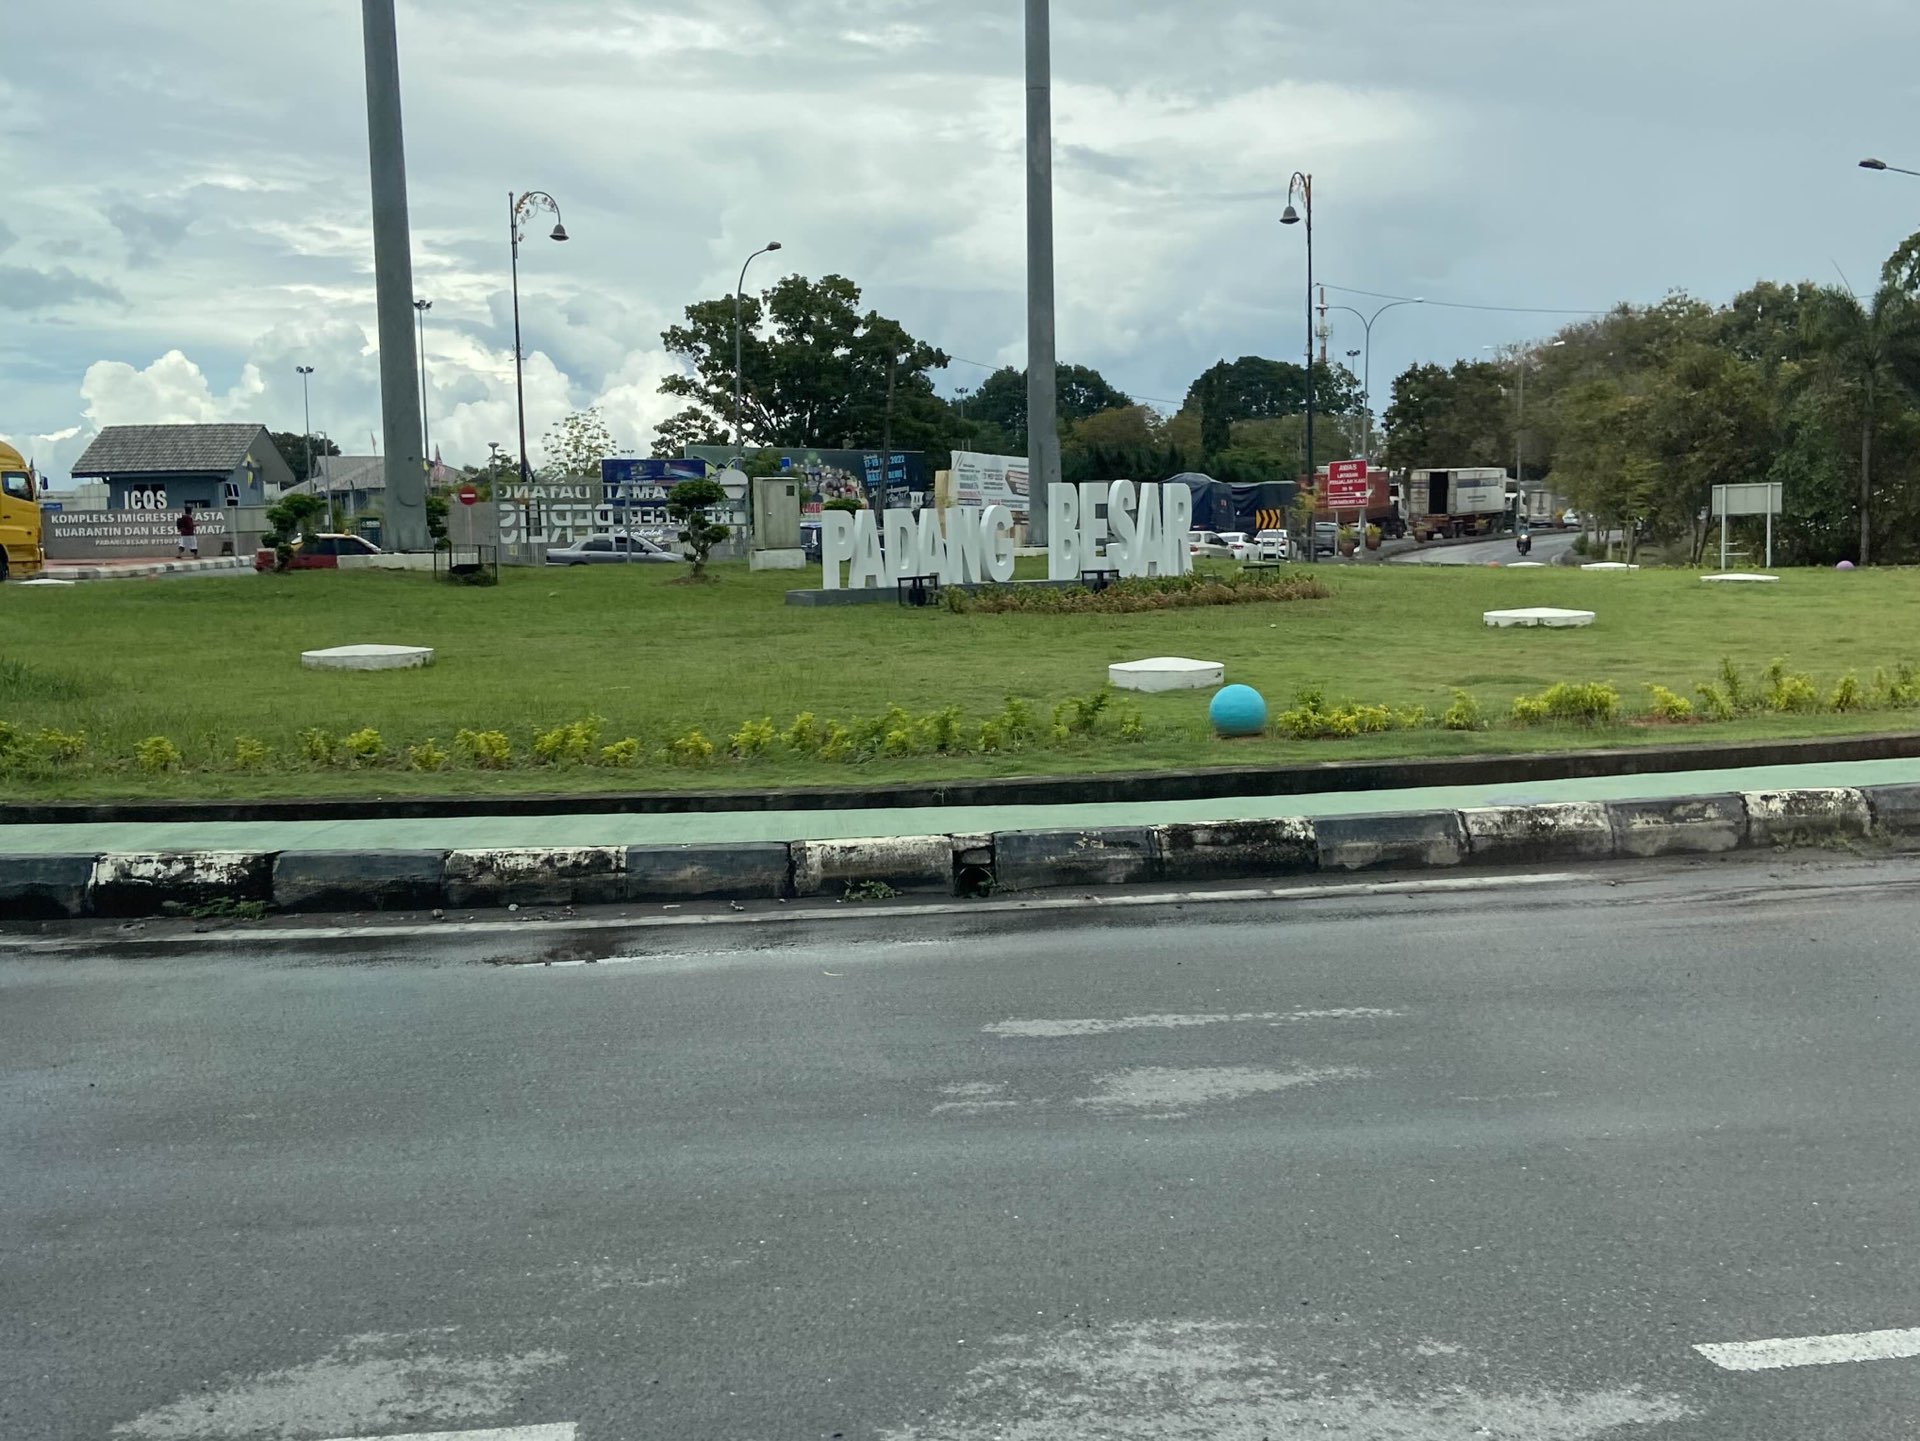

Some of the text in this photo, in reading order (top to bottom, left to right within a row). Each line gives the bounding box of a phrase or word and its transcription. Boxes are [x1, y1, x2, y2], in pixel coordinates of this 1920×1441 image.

[124, 491, 168, 510] ICQS
[51, 514, 114, 524] KOMPLEKS
[117, 512, 182, 523] IMIGRESEN
[55, 527, 121, 537] KUARANTIN
[125, 526, 148, 536] DAN
[822, 480, 1193, 589] PADANG BESAR
